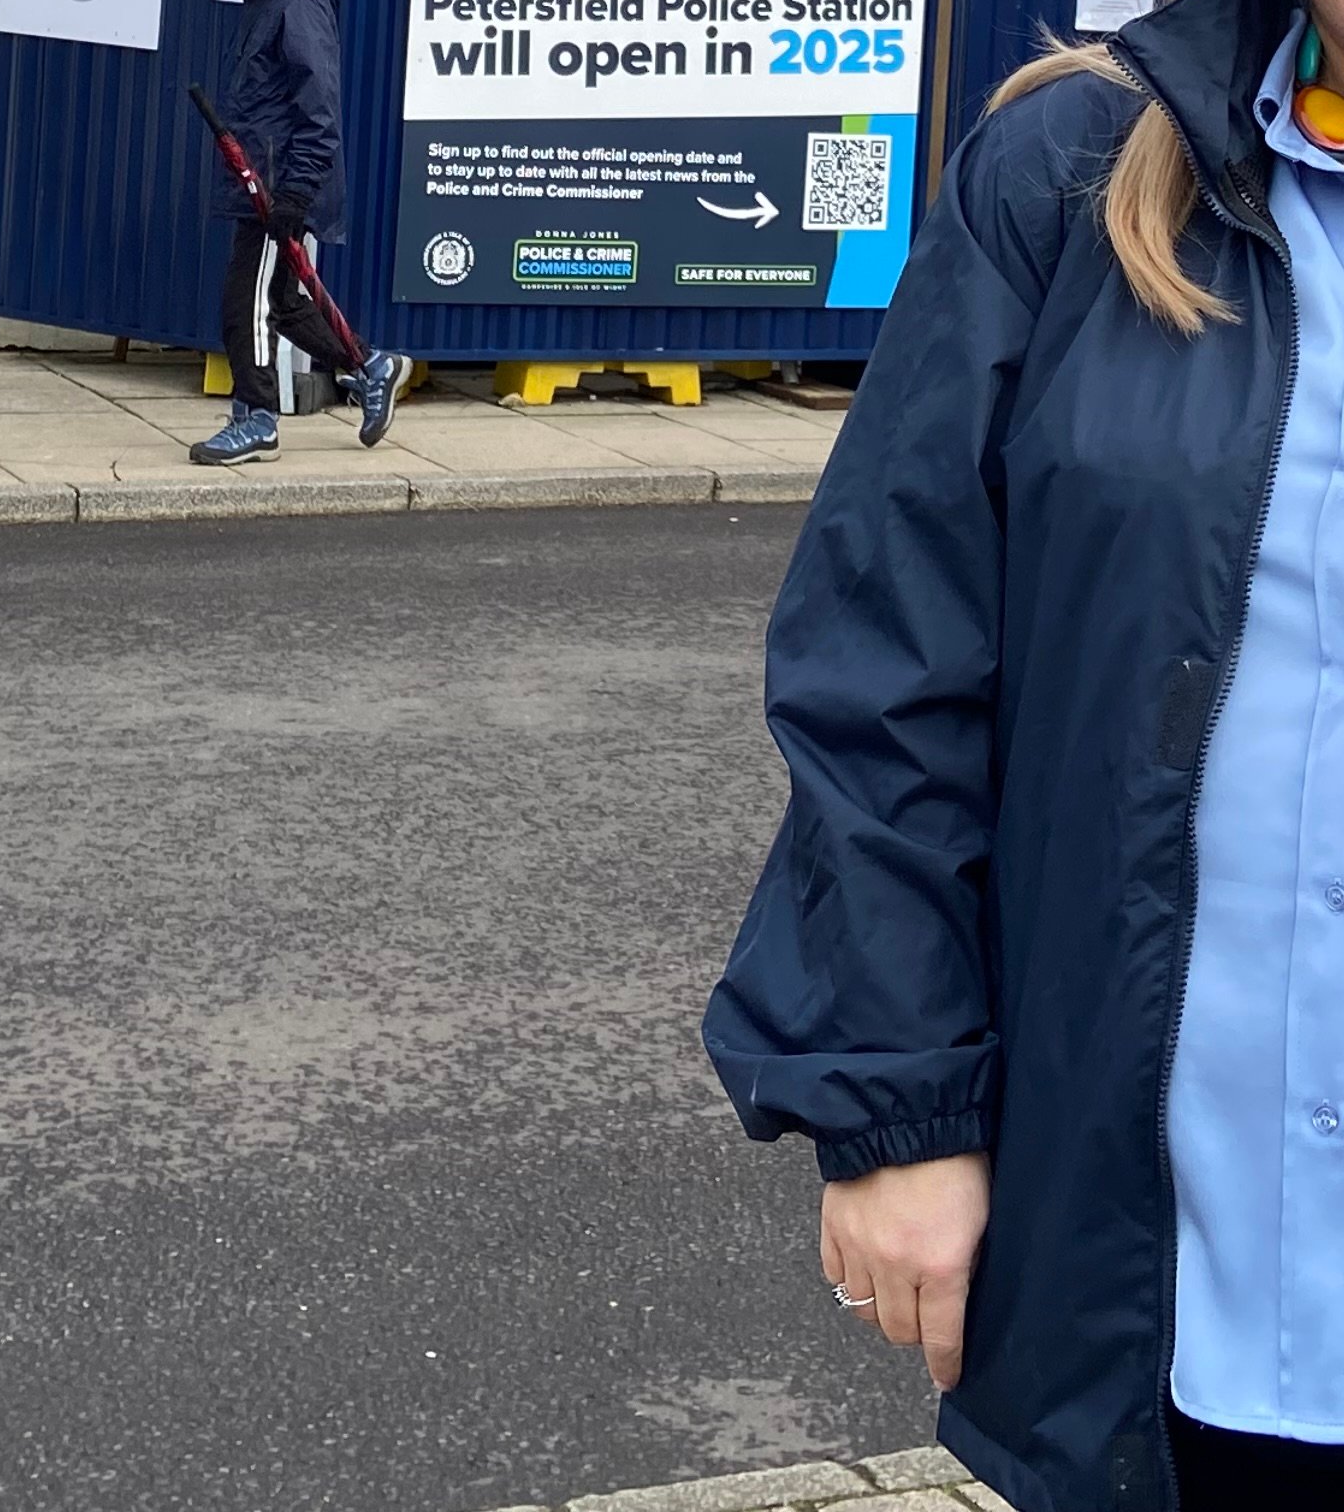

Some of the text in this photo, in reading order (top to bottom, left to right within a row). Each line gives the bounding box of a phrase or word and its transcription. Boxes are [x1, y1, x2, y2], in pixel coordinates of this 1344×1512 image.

[430, 25, 906, 88] will open in 2025
[428, 143, 743, 166] Sign up to find out the official opening date and
[427, 163, 756, 183] to stay up to date with all the latest news from the
[426, 181, 644, 199] Police and Crime Commissioner
[519, 246, 632, 261] POLICE & CRIME
[518, 261, 632, 276] COMMISSIONER
[681, 268, 811, 281] SAFE FOR EVERYONE
